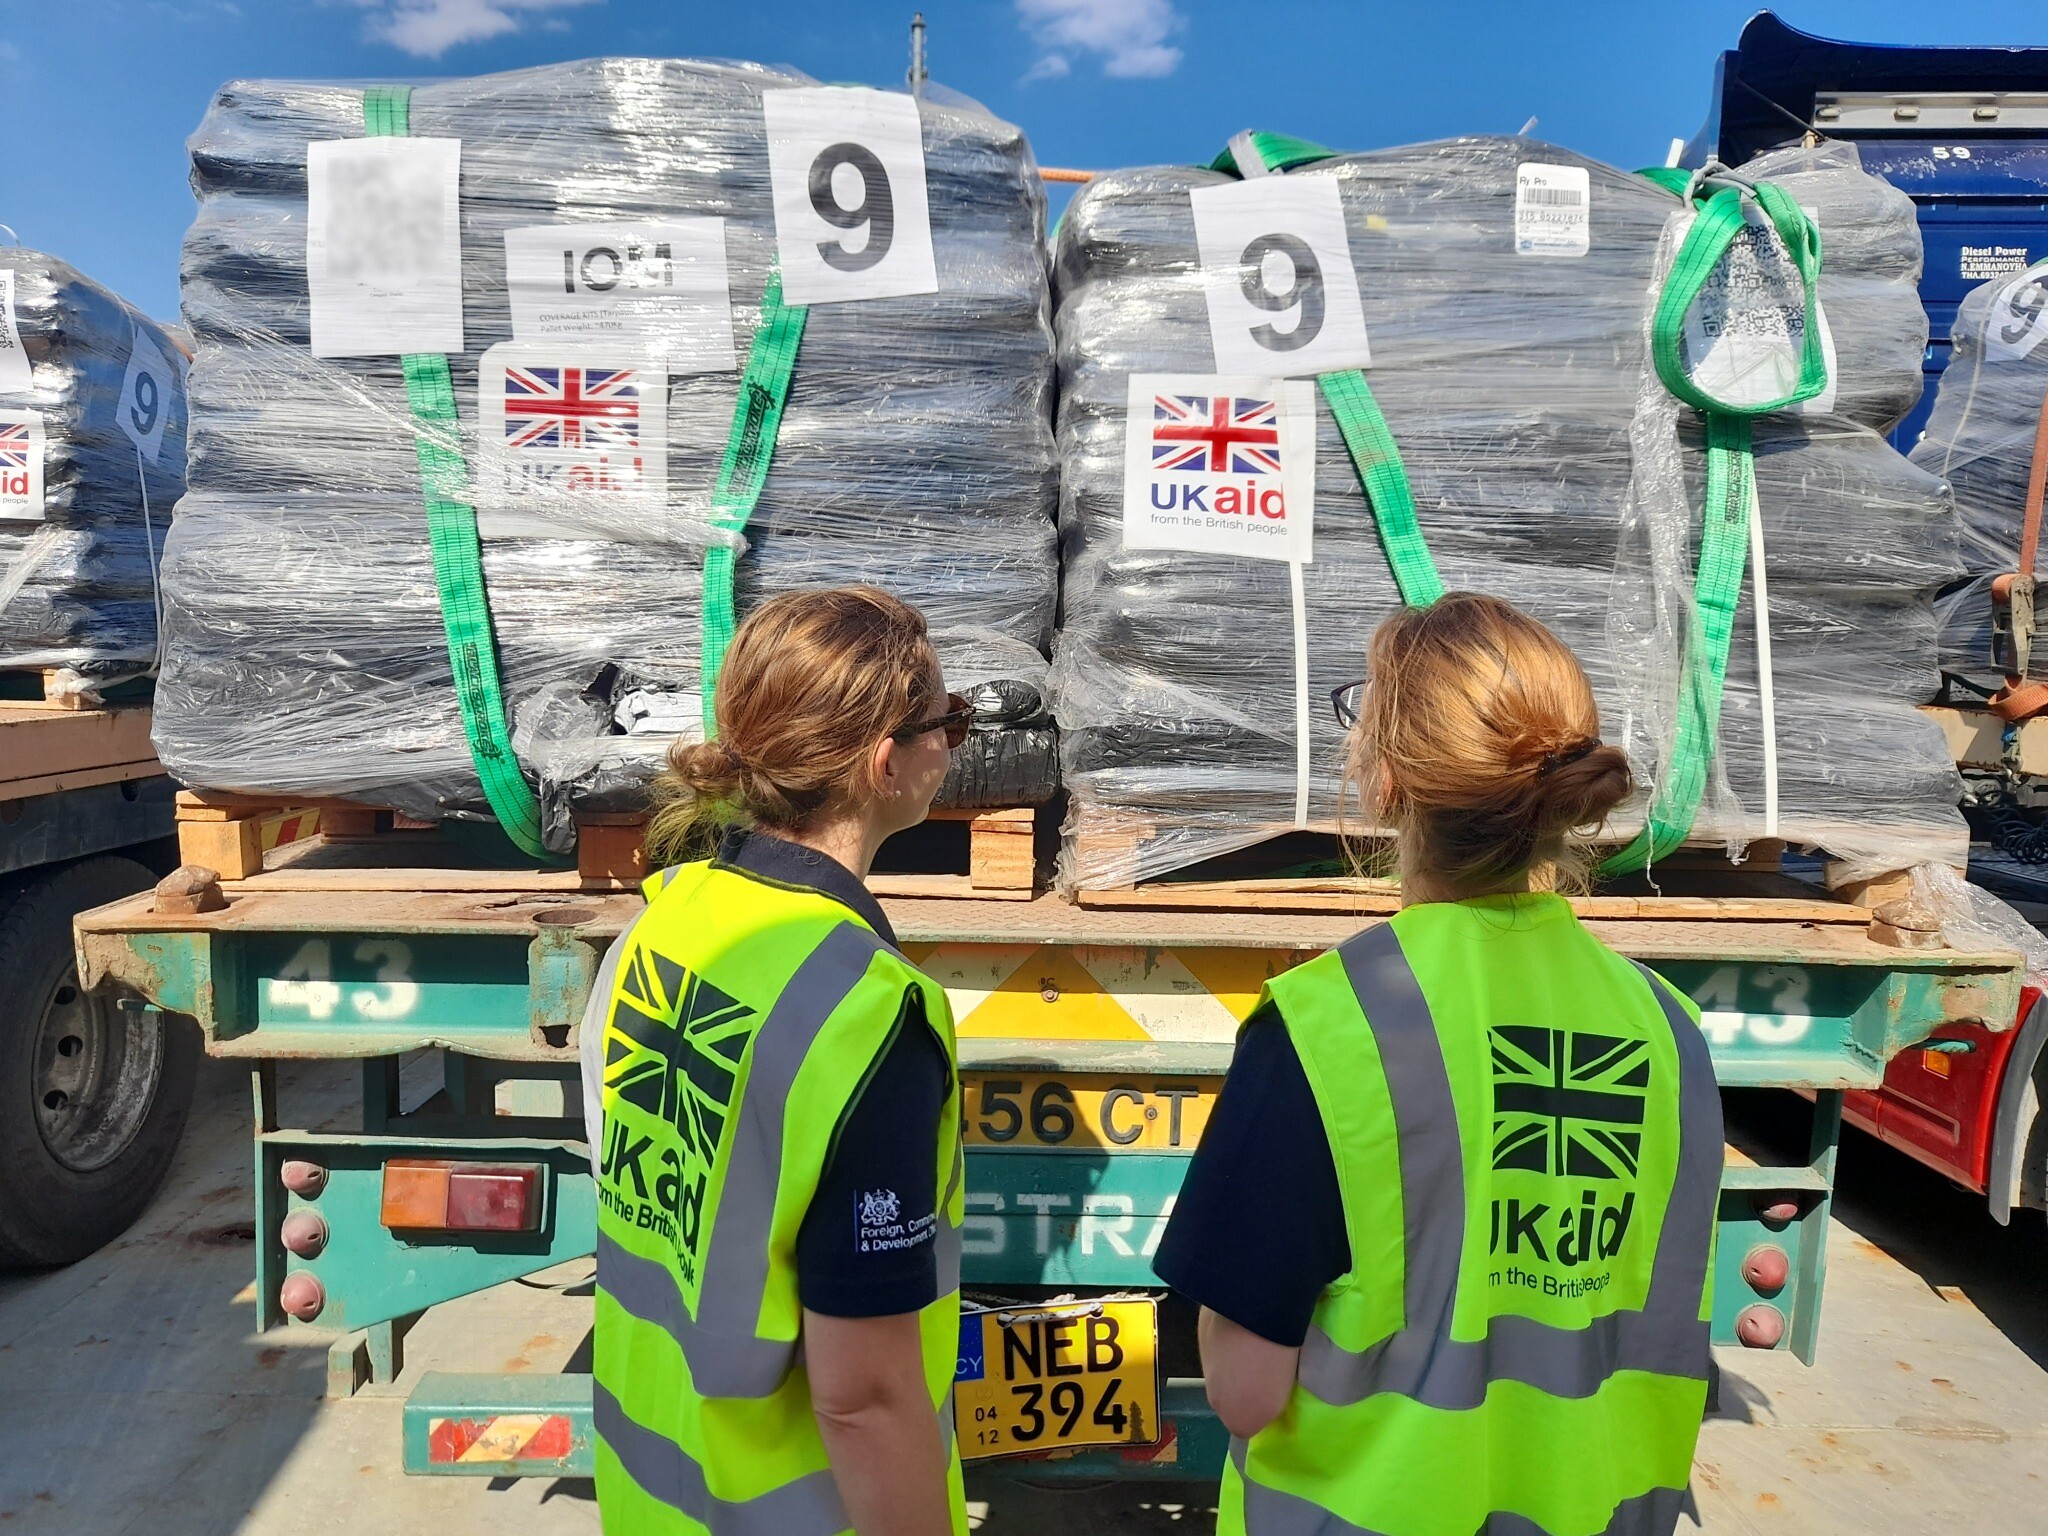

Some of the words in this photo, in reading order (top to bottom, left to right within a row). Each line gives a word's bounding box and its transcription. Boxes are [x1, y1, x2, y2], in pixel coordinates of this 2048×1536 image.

[1933, 146, 1971, 160] 59
[808, 142, 894, 272] 9
[1961, 246, 1992, 256] Diesel
[1995, 246, 2028, 256] Power
[1239, 233, 1326, 352] 9
[2001, 275, 2048, 344] 9
[131, 371, 159, 436] 9
[1151, 513, 1179, 525] from
[1183, 515, 1202, 526] the
[1206, 517, 1244, 530] British
[1247, 522, 1288, 536] people
[268, 938, 421, 1019] 43
[1690, 966, 1813, 1044] 43
[614, 1190, 634, 1222] the
[861, 1240, 870, 1252] &
[1506, 1266, 1538, 1289] the
[1543, 1274, 1585, 1298] Britis
[955, 1355, 983, 1375] CY
[1003, 1317, 1124, 1381] NEB
[975, 1405, 998, 1422] 04
[1011, 1378, 1128, 1442] 394
[977, 1430, 999, 1445] 12
